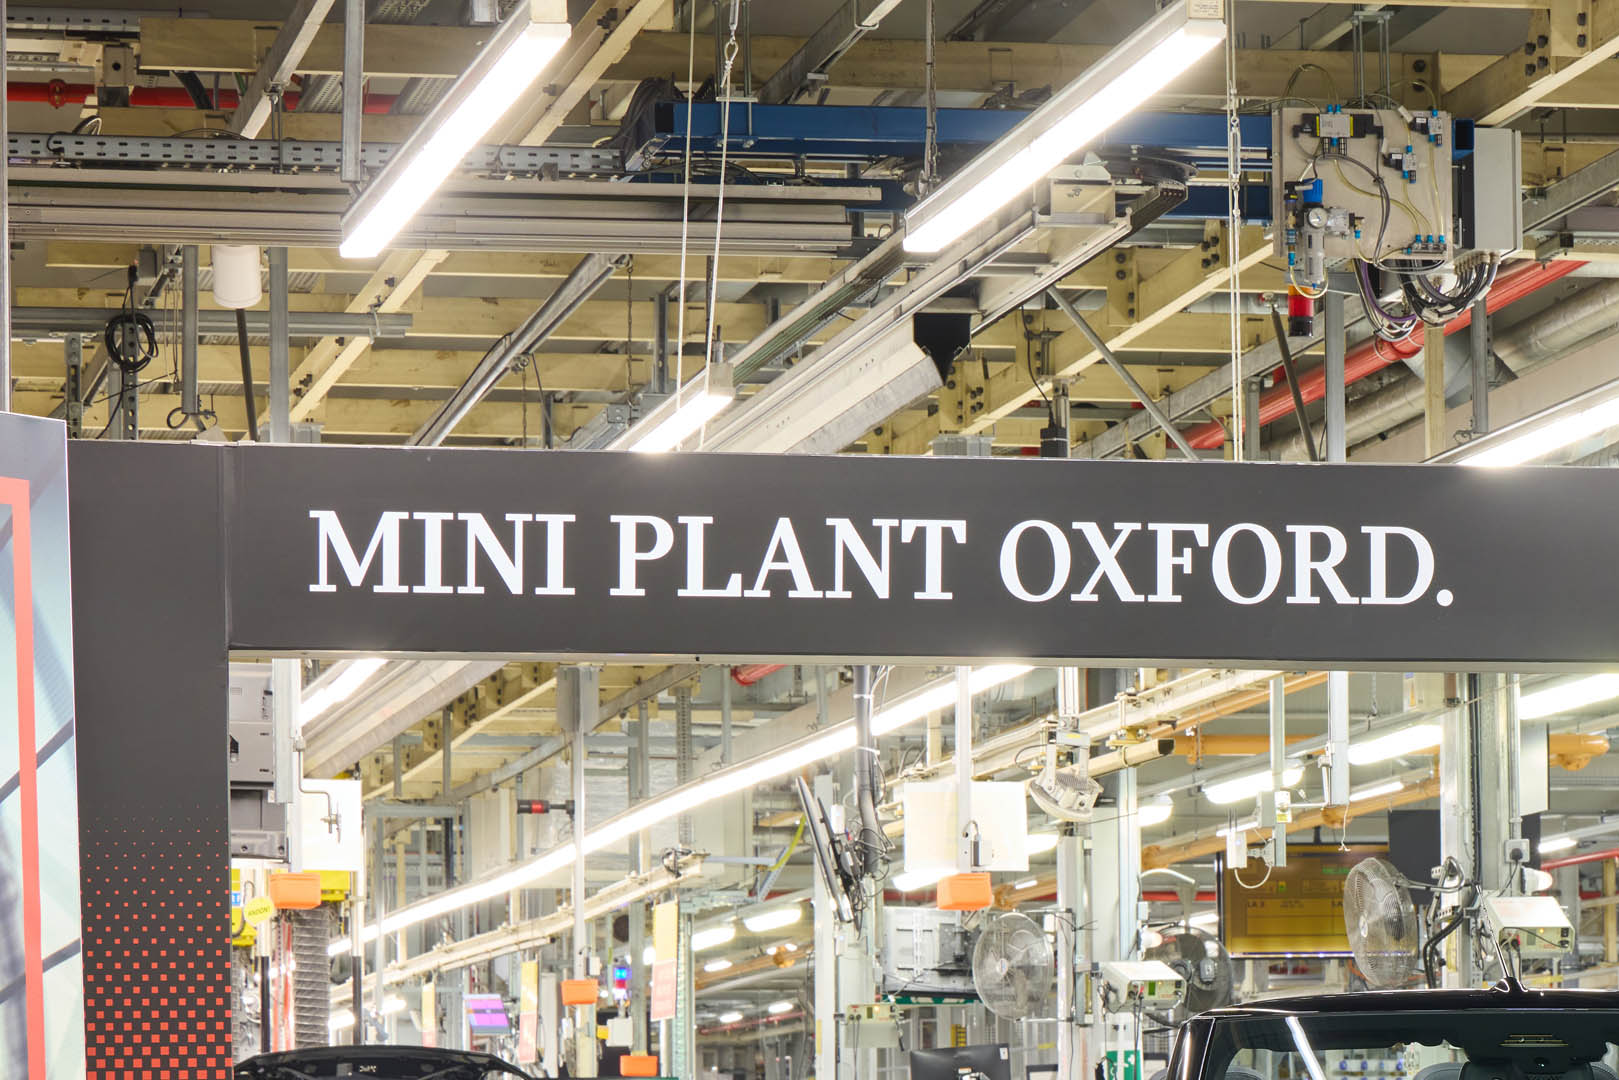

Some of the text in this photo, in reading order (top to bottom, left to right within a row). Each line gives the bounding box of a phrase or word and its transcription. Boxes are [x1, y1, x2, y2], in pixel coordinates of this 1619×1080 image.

[308, 509, 1455, 607] MINI PLANT OXFORD.
